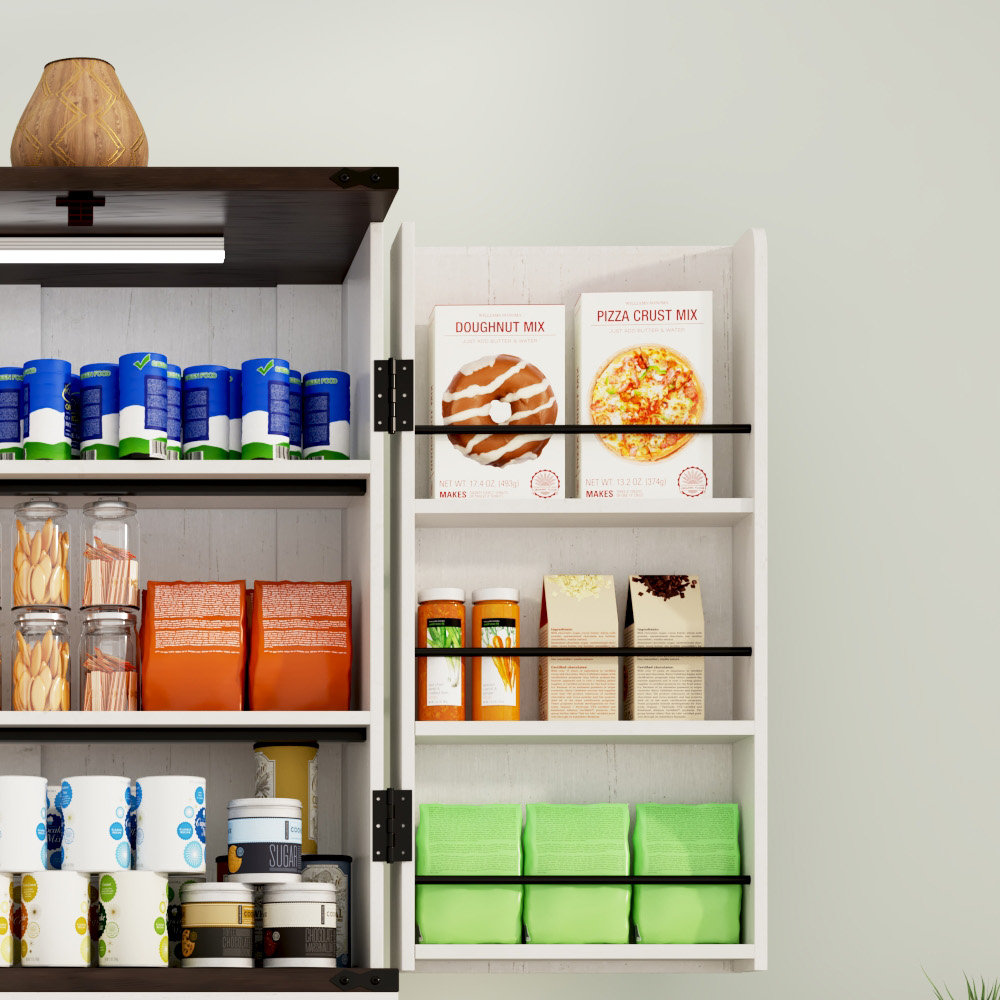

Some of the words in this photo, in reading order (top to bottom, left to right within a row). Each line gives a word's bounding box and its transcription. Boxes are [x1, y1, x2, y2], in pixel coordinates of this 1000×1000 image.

[597, 310, 629, 322] PIZZA
[633, 309, 672, 321] CRUST
[676, 309, 698, 321] MIX
[455, 321, 520, 333] DOUGHNUT
[523, 321, 545, 333] MIX
[439, 491, 467, 499] MAKES
[585, 490, 614, 498] MAKES
[269, 844, 298, 868] SUGAR
